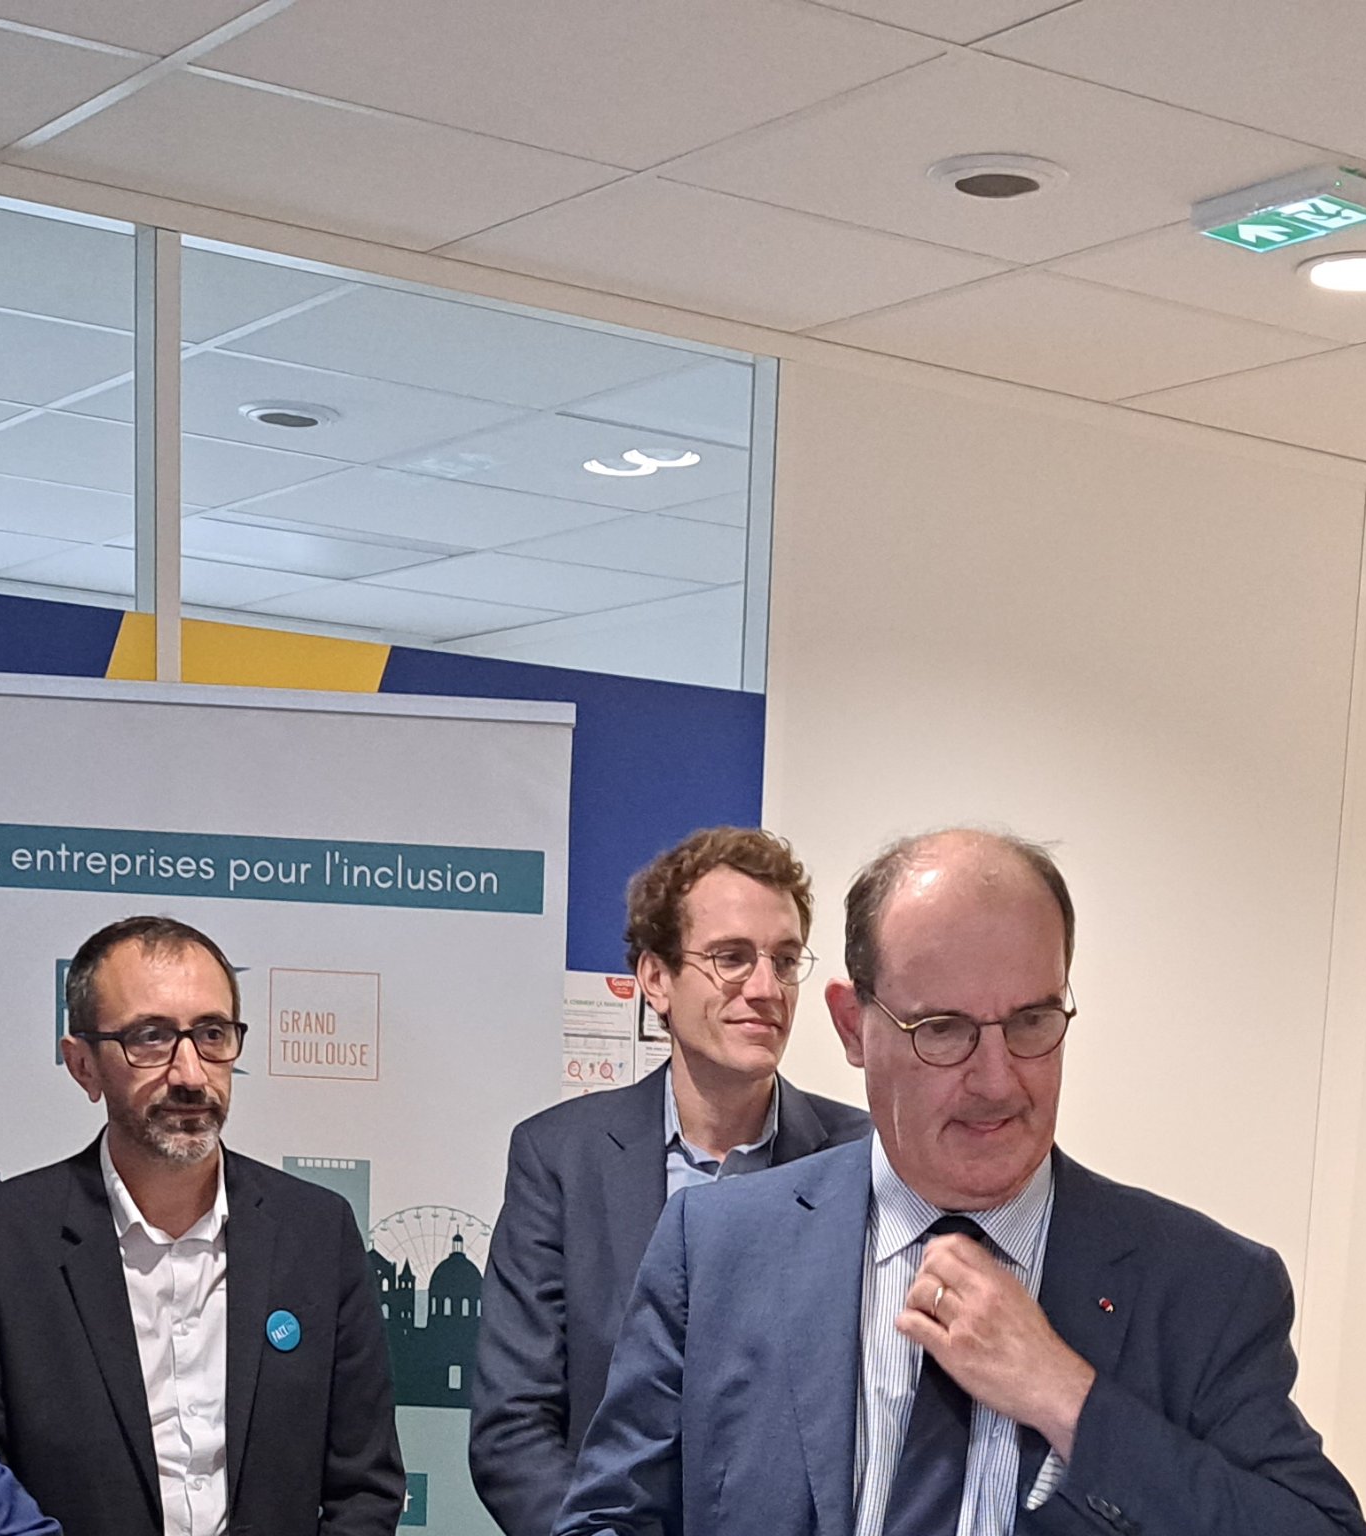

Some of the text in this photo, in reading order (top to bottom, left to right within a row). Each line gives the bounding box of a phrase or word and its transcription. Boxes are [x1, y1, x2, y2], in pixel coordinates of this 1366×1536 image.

[11, 843, 216, 885] entreprises
[229, 858, 312, 892] pour
[325, 850, 499, 895] l'inclusion
[280, 1009, 336, 1036] GRAND
[280, 1039, 370, 1067] TOULOUSE
